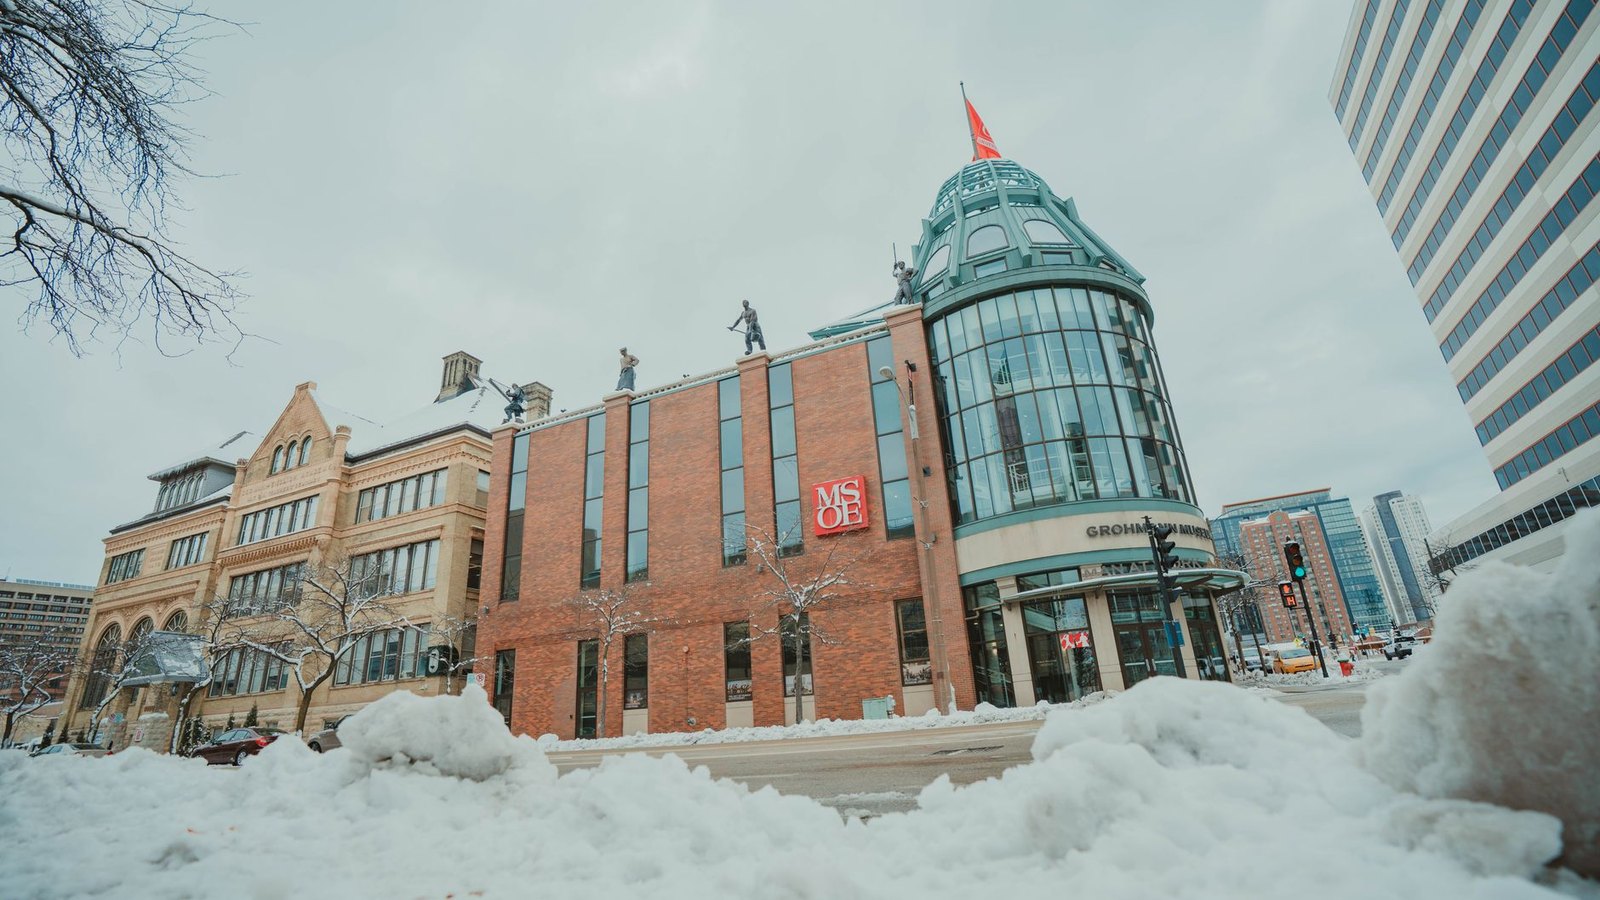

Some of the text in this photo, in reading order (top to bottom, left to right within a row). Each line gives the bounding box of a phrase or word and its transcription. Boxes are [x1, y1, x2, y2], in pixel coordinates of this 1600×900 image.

[1086, 522, 1178, 538] GROHMNN
[1129, 560, 1149, 574] AT
[1167, 558, 1203, 570] ORK
